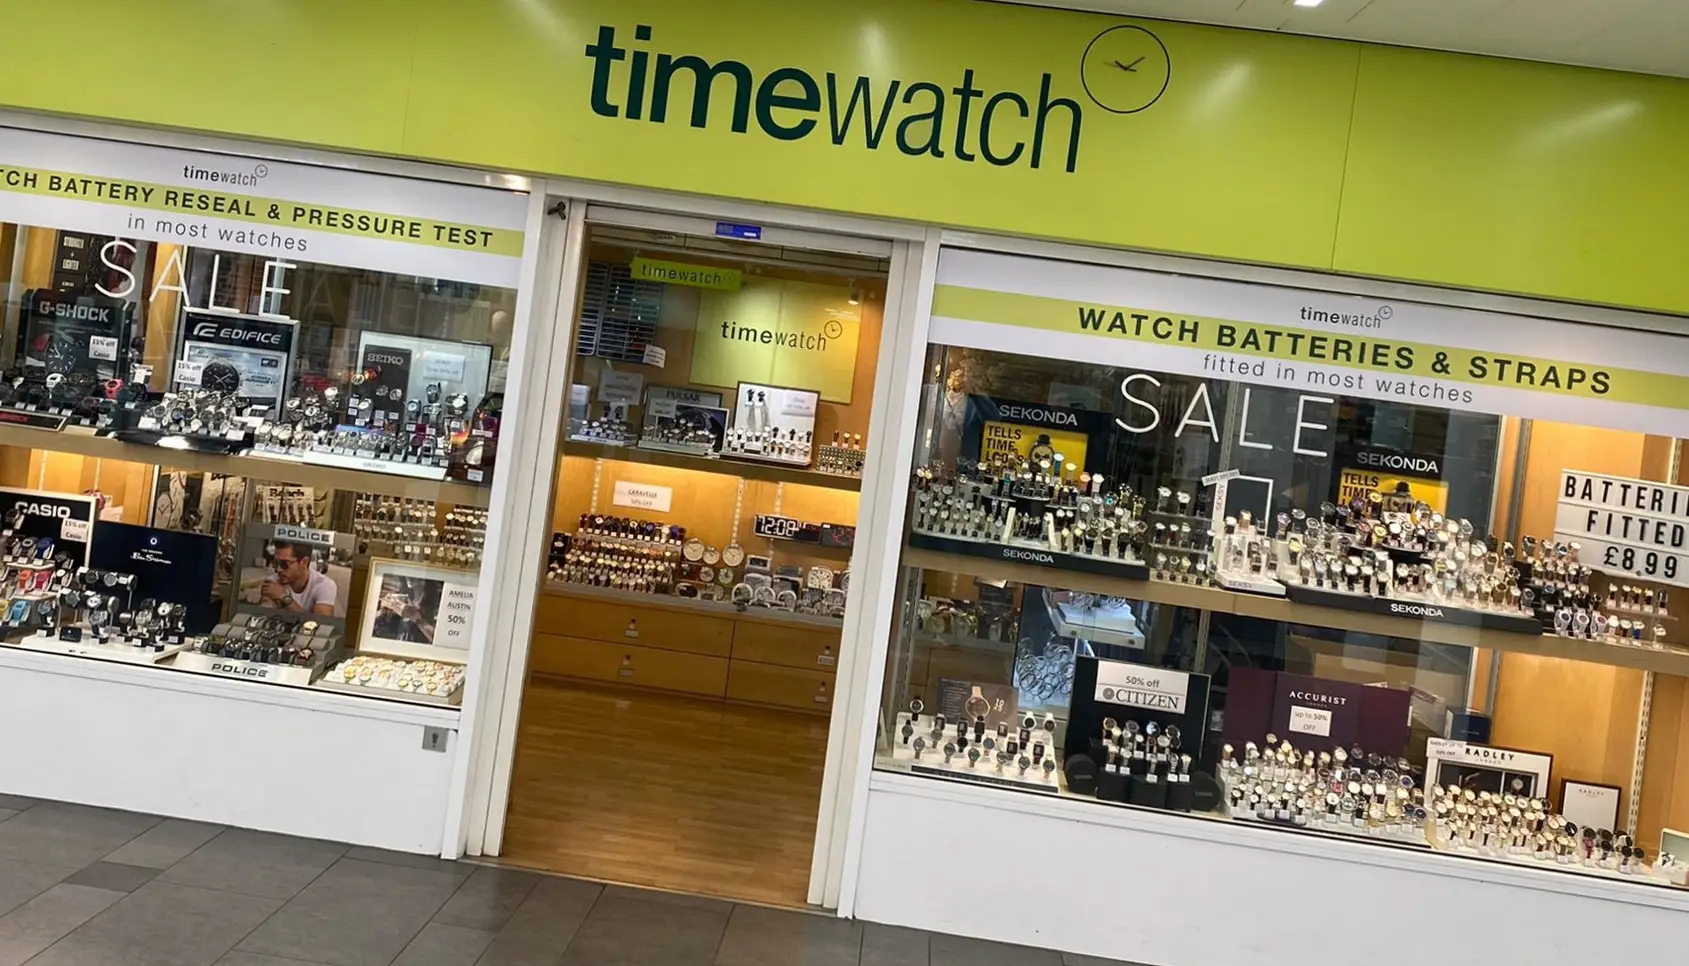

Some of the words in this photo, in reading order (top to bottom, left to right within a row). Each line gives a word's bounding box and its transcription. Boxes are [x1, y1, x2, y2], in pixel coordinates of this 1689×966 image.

[585, 24, 1083, 173] timewatch
[184, 165, 258, 187] timewatch
[49, 175, 155, 203] BATTERY
[165, 190, 256, 217] RESEAL
[267, 203, 282, 220] &
[293, 207, 422, 239] PRESSURE
[433, 225, 494, 248] TEST
[128, 213, 145, 230] in
[156, 219, 208, 239] most
[218, 228, 308, 252] watches
[94, 240, 298, 320] SALE
[641, 263, 721, 285] timewatch
[39, 301, 110, 323] G-SHOCK
[1300, 306, 1382, 329] timewatch
[219, 324, 282, 345] EDIFICE
[721, 320, 827, 352] timewatch
[367, 352, 404, 365] SEIKO
[1078, 307, 1200, 343] WATCH
[1216, 324, 1414, 370] BATTERIES
[1431, 351, 1452, 375] &
[1468, 355, 1612, 395] STRAPS
[1203, 354, 1265, 378] fitted
[1276, 362, 1295, 381] in
[1308, 368, 1365, 391] most
[1375, 377, 1473, 404] watches
[666, 390, 701, 402] PULSAR
[999, 404, 1078, 426] SEKONDA
[1115, 372, 1335, 458] SALE
[987, 425, 1022, 440] TELLS
[1356, 452, 1439, 474] SEKONDA
[1343, 472, 1379, 488] TELLS
[1565, 475, 1689, 517] BATTERI
[15, 501, 71, 518] CASIO
[278, 528, 330, 542] POLICE
[758, 515, 797, 537] 12:08
[1586, 509, 1685, 547] FITTED
[1002, 548, 1054, 564] SEKONDA
[1603, 546, 1678, 579] £8.99
[448, 590, 474, 598] AMELIA
[447, 601, 471, 610] AUSTIN
[1391, 602, 1444, 618] SEKONDA
[447, 614, 466, 624] 50%
[211, 663, 269, 678] POLICE
[1125, 675, 1144, 686] 50%
[1146, 679, 1160, 688] off
[1116, 689, 1179, 709] CITIZEN
[1289, 690, 1347, 705] ACCURIST
[1465, 748, 1515, 761] RADLEY
